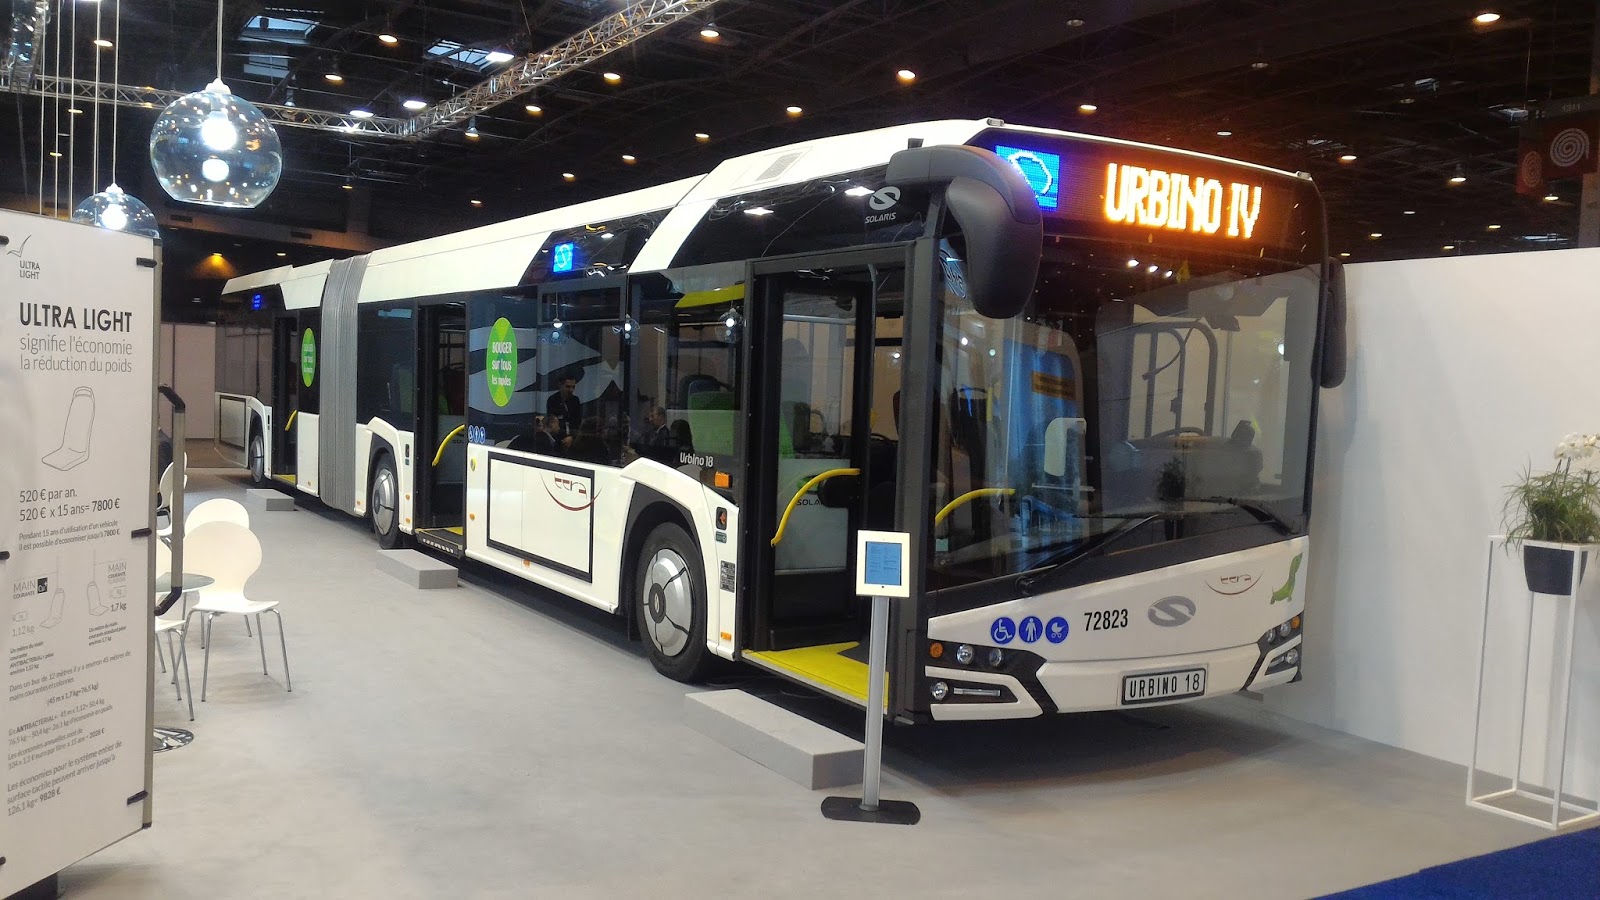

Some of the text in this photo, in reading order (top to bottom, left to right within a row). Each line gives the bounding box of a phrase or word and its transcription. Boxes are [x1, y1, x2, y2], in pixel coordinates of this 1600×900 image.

[1105, 162, 1224, 234] URBINO
[865, 212, 896, 224] SOLARIS
[20, 260, 40, 270] ULTRA
[20, 271, 39, 279] LIGHT
[20, 302, 132, 332] ULTRA LIGHT
[20, 333, 132, 355] signifie l'économie
[492, 342, 512, 353] BOUGER
[21, 354, 132, 374] la réduction du poids
[501, 360, 512, 371] tous
[680, 452, 714, 468] Urbino 18
[19, 488, 78, 503] 520 € par an.
[19, 508, 38, 521] 520
[40, 507, 46, 519] €
[50, 508, 55, 517] x
[58, 504, 68, 517] 15
[92, 498, 112, 512] 7800
[114, 498, 120, 509] €
[19, 532, 41, 540] Pendant
[60, 524, 88, 534] d'utilisation
[24, 542, 32, 550] est
[33, 540, 54, 550] possible
[108, 562, 127, 572] MAIN
[14, 579, 36, 592] MAIN
[13, 591, 35, 599] COURANTE
[120, 602, 126, 610] kg
[1084, 609, 1128, 631] 72823
[27, 625, 34, 634] kg
[9, 684, 22, 692] Dans
[49, 673, 55, 681] 12
[56, 669, 73, 679] mètres
[1129, 672, 1200, 698] URBINO 18
[7, 783, 18, 792] Les
[19, 769, 52, 788] économies
[53, 763, 67, 775] pour
[74, 752, 97, 766] système
[98, 745, 114, 755] entier
[115, 740, 122, 748] de
[7, 754, 116, 804] surface tactile peuvent arriver jusqu'à
[7, 801, 26, 816] 126,1
[40, 789, 55, 802] 9828
[56, 787, 61, 795] €
